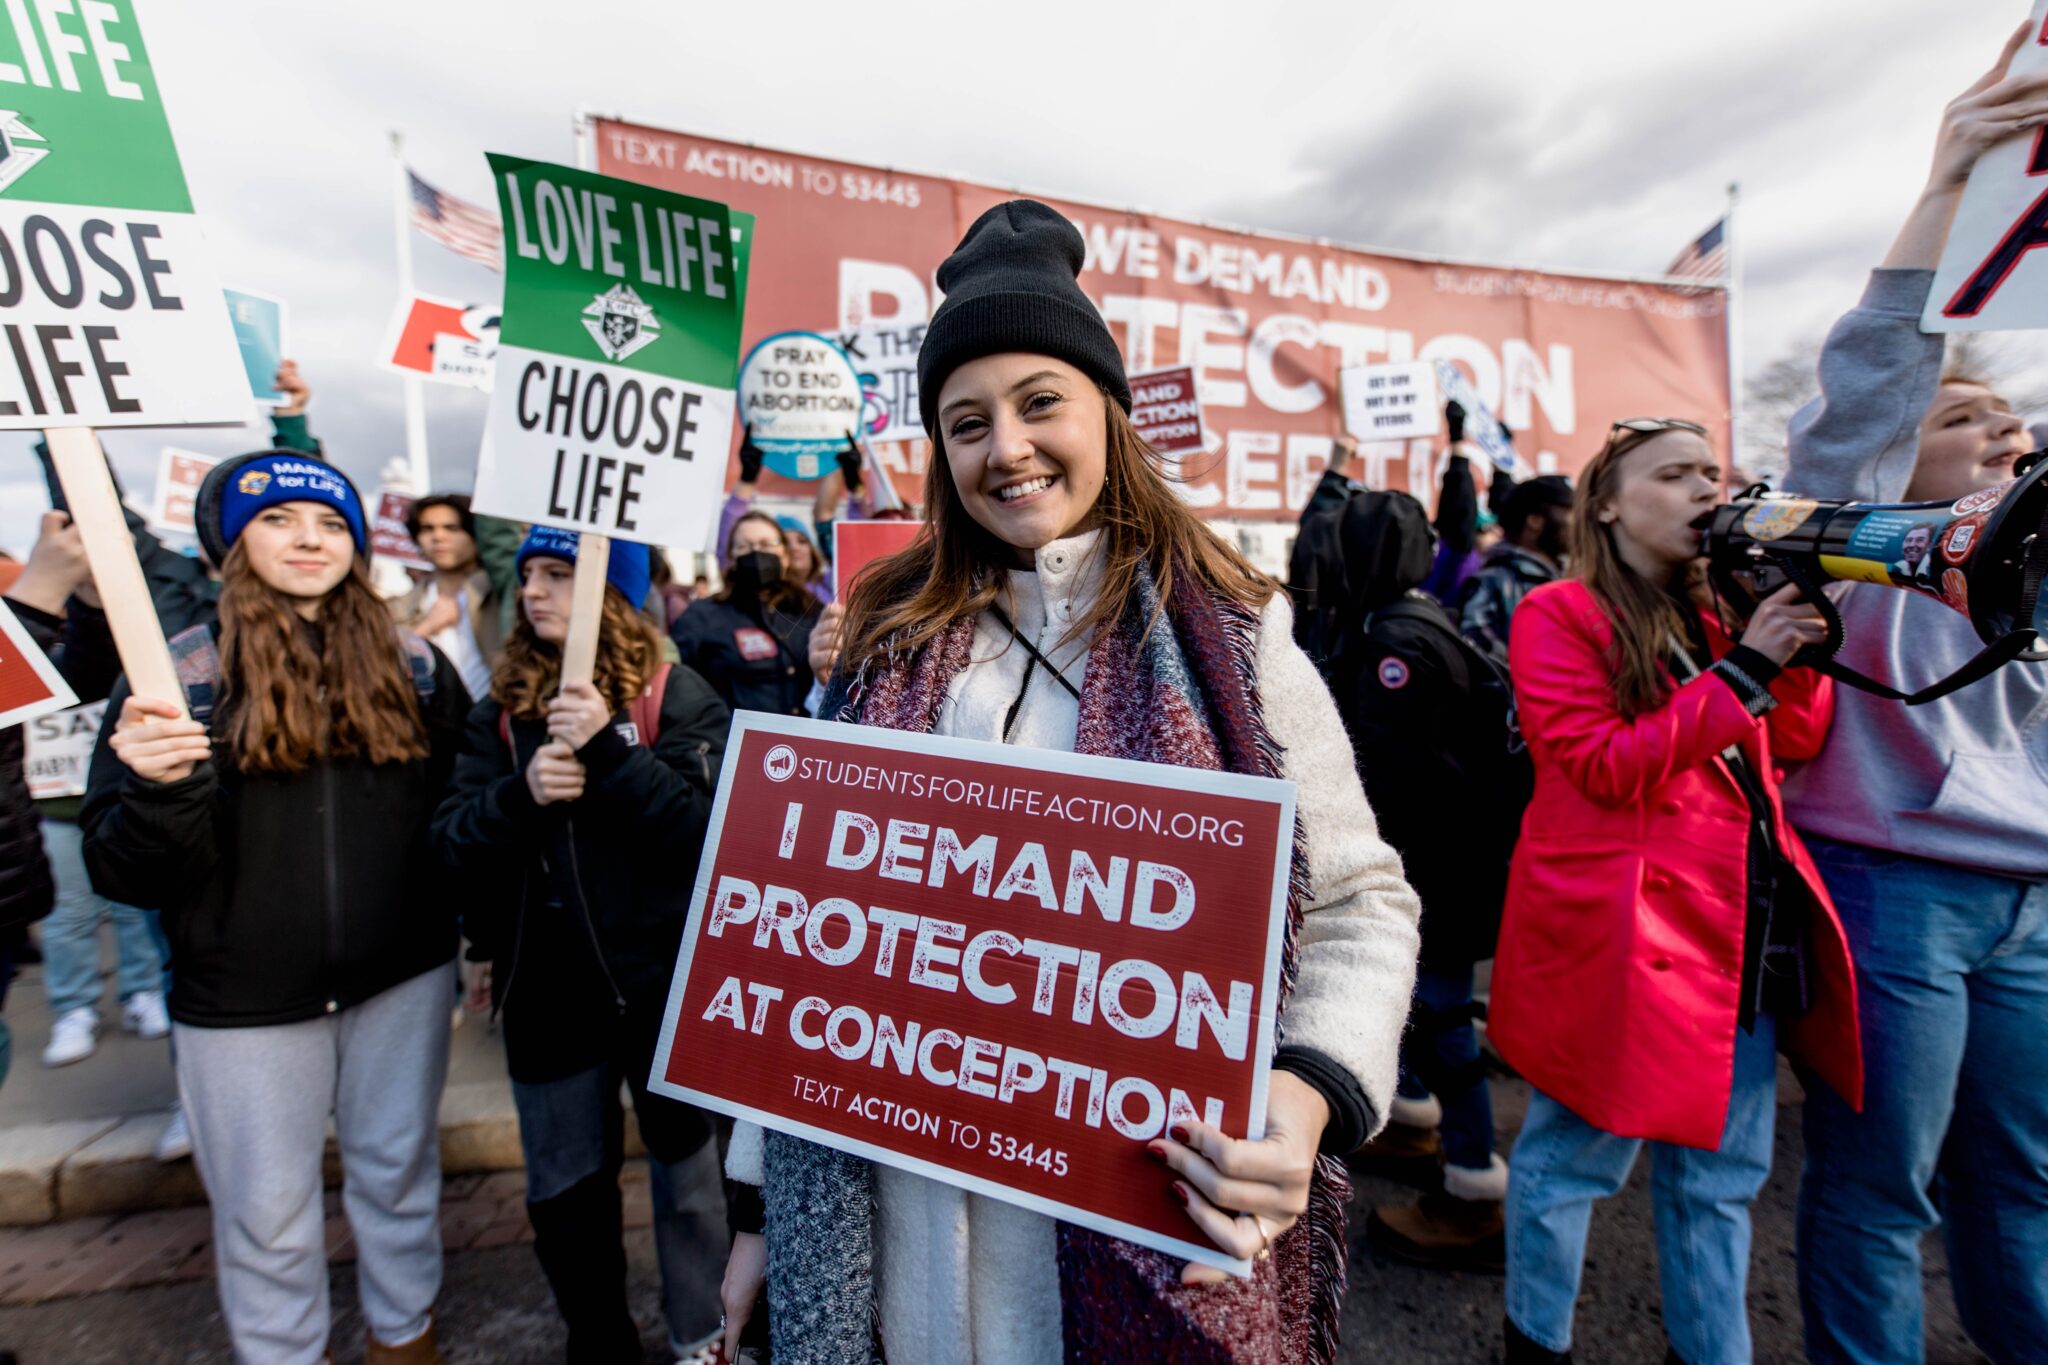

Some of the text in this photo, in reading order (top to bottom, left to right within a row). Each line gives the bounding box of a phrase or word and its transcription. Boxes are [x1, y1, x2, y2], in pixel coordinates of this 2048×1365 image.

[608, 133, 921, 208] TEXT ACTION TO 53445
[506, 172, 625, 277] LOVE
[632, 202, 727, 299] LIFE
[1072, 221, 1391, 311] WE DEMAND
[760, 369, 841, 389] TO END
[774, 347, 827, 365] PRAY
[1134, 384, 1182, 405] AND
[517, 361, 702, 462] CHOOSE
[748, 393, 855, 411] ABORTION
[1130, 400, 1198, 426] CTION
[548, 449, 645, 532] LIFE
[799, 757, 1244, 847] STUDENTSFORLIFEACTION.ORG
[777, 802, 1197, 932] I DEMAND
[707, 875, 1254, 1062] PROTECTION
[702, 976, 1225, 1142] AT CONCEPTION
[792, 1074, 1069, 1178] TEXT ACTION TO 53445
